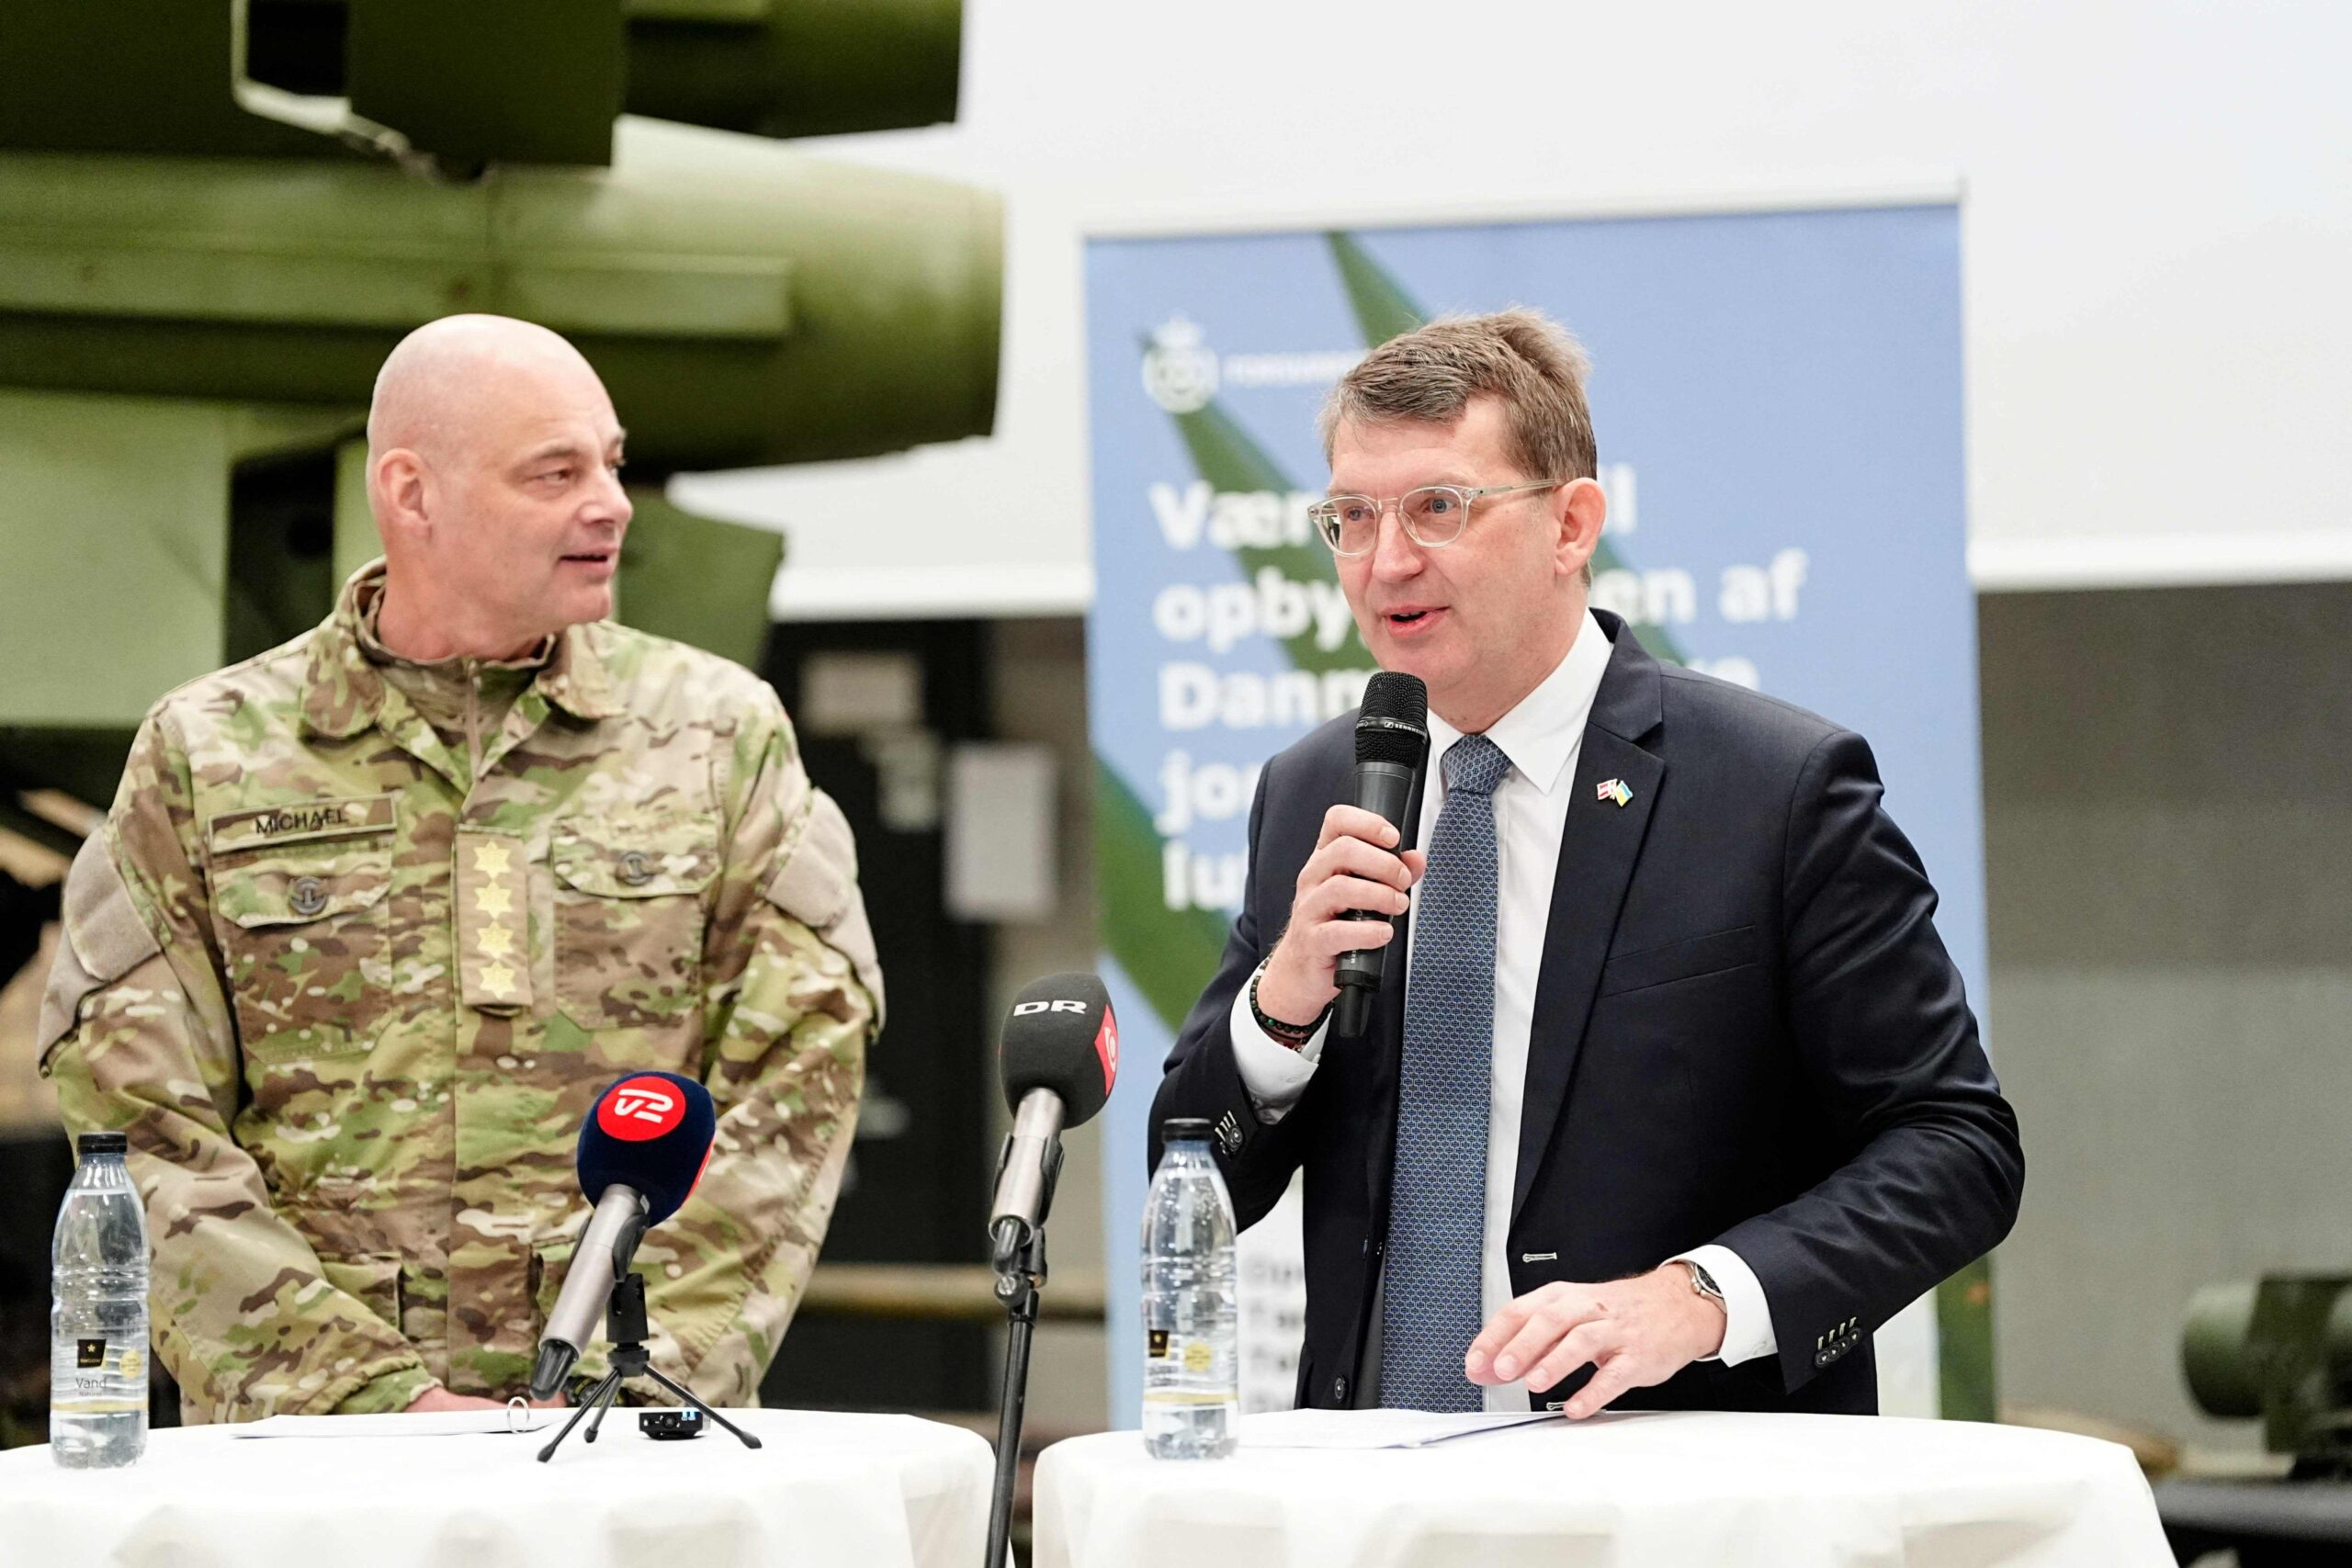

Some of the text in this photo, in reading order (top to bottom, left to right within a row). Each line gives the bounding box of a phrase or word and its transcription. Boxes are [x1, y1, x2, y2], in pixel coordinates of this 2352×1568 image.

[1719, 547, 1806, 623] af
[255, 807, 349, 835] MICHAEL
[1012, 999, 1087, 1017] DR
[75, 1377, 107, 1389] Vand
